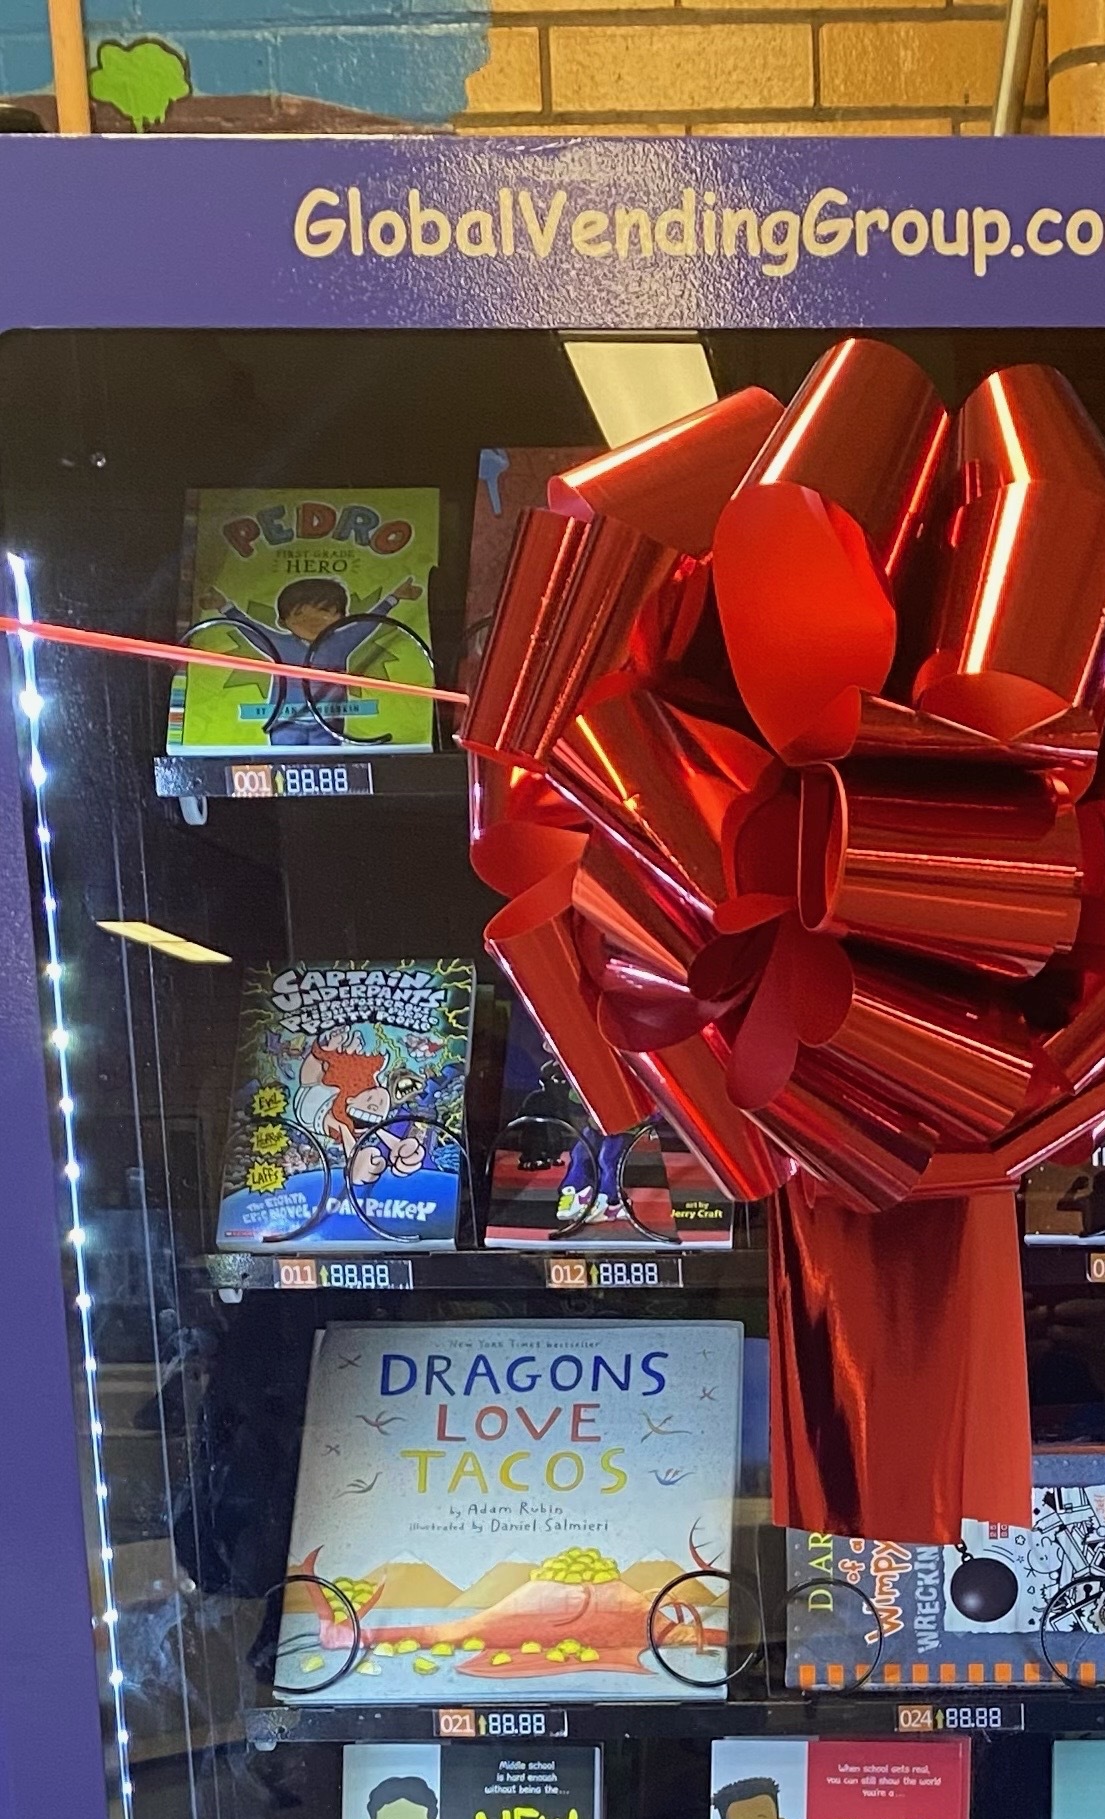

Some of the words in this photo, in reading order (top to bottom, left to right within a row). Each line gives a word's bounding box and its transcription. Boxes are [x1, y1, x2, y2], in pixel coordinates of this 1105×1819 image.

[222, 501, 413, 558] PEDRO
[286, 560, 347, 573] HERO
[233, 770, 271, 792] 001
[286, 768, 349, 793] 88.88
[272, 985, 446, 1011] UNDERPANTS
[670, 1208, 696, 1219] Jerry
[697, 1208, 723, 1219] Craft
[281, 1264, 316, 1286] 011
[330, 1264, 389, 1287] 88.88
[551, 1264, 585, 1285] 012
[600, 1262, 659, 1286] 88.88
[380, 1351, 669, 1397] DRAGONS
[436, 1403, 601, 1443] LOVE
[401, 1447, 628, 1495] TACOS
[449, 1504, 461, 1518] by
[468, 1503, 512, 1516] Adam
[519, 1501, 564, 1516] Rubin
[408, 1520, 465, 1532] illustrated
[472, 1520, 483, 1534] by
[490, 1519, 537, 1533] Daniel
[544, 1517, 609, 1533] Salmieri
[838, 1558, 866, 1585] of
[863, 1540, 912, 1646] Wimpy
[915, 1546, 944, 1653] WRECKIN
[440, 1715, 474, 1733] 021
[488, 1712, 546, 1735] 88.88
[900, 1708, 932, 1728] 024
[946, 1707, 1001, 1729] 88.88
[499, 1760, 526, 1771] Middle
[528, 1760, 555, 1771] school
[838, 1763, 861, 1773] When
[863, 1764, 888, 1773] school
[891, 1765, 910, 1774] gets
[912, 1765, 931, 1775] real,
[484, 1784, 517, 1795] without
[519, 1784, 541, 1795] being
[496, 1773, 504, 1782] is
[506, 1773, 526, 1782] hard
[527, 1773, 558, 1783] enough
[843, 1777, 858, 1785] can
[861, 1776, 876, 1785] still
[879, 1776, 900, 1785] show
[903, 1776, 917, 1786] the
[919, 1776, 942, 1786] world
